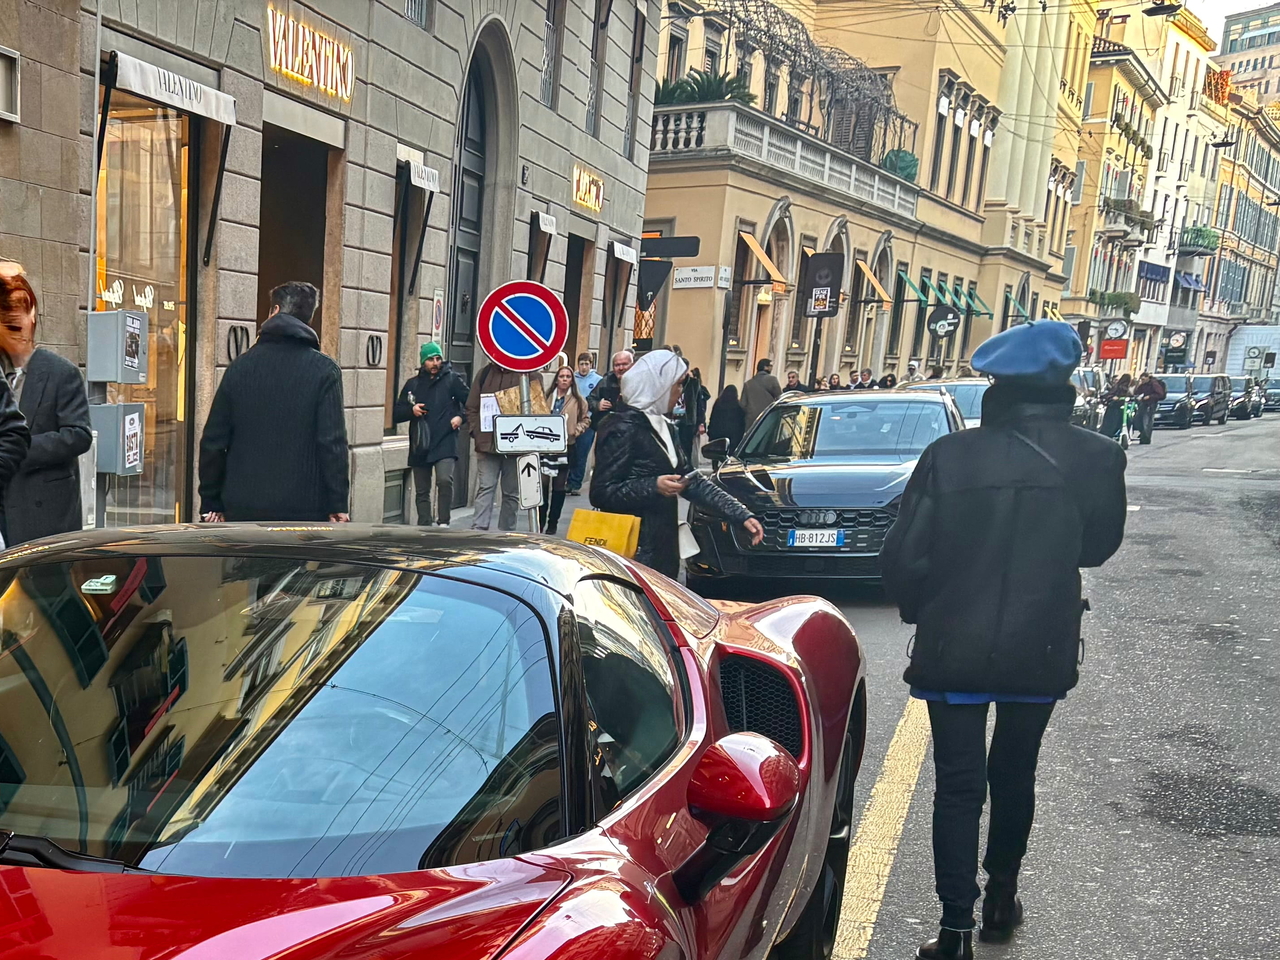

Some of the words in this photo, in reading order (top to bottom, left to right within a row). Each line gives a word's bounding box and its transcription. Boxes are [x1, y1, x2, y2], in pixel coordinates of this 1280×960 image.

[267, 8, 356, 100] VALENTINO
[157, 66, 202, 104] VALENTINO
[583, 536, 607, 546] FENDI
